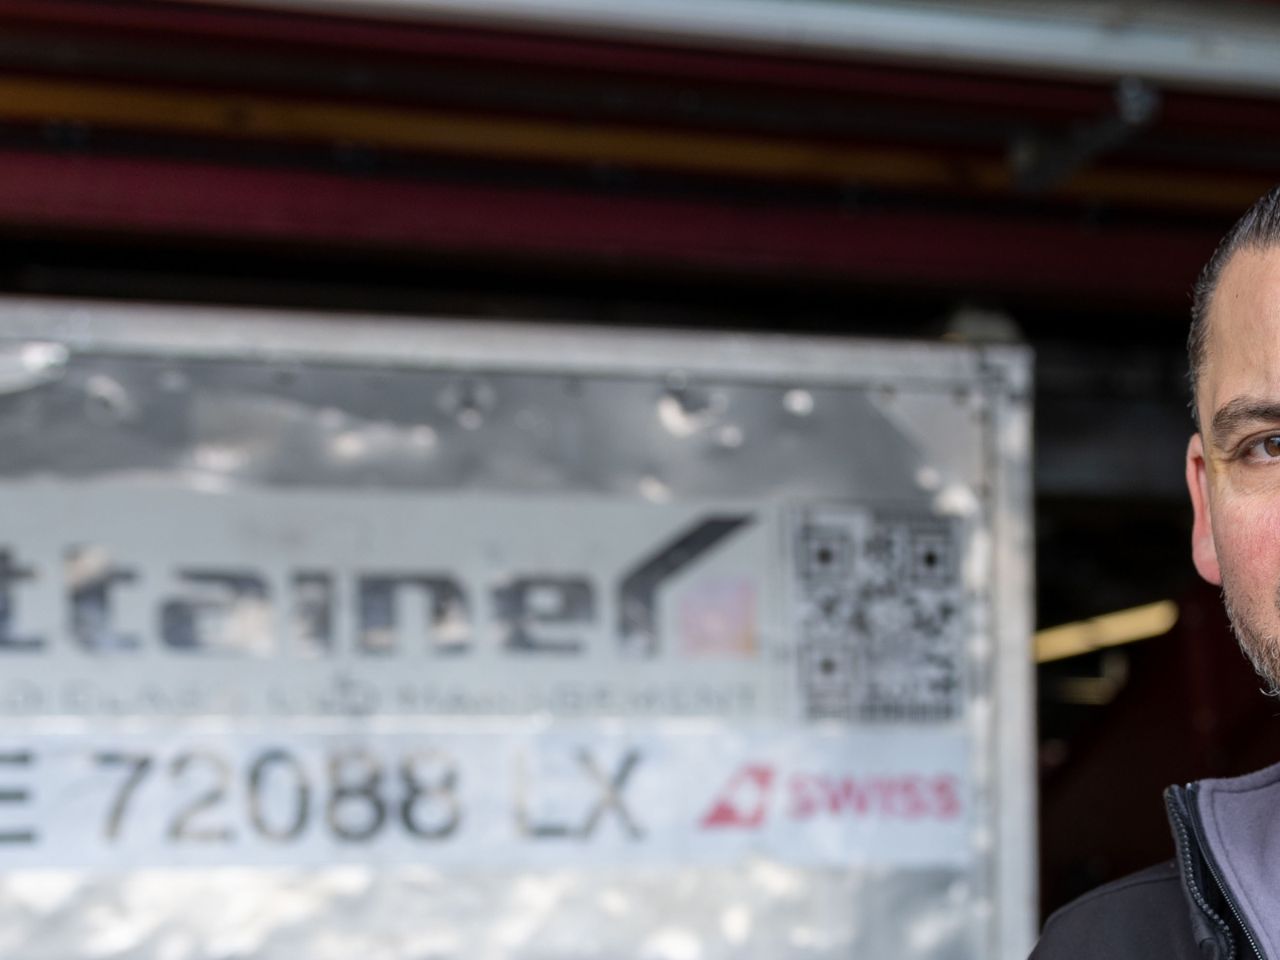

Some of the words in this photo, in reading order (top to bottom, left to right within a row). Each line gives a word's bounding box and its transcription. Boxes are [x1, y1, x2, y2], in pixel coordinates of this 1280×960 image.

[91, 747, 467, 845] 72088
[512, 747, 645, 844] LX
[788, 774, 961, 821] SWISS
